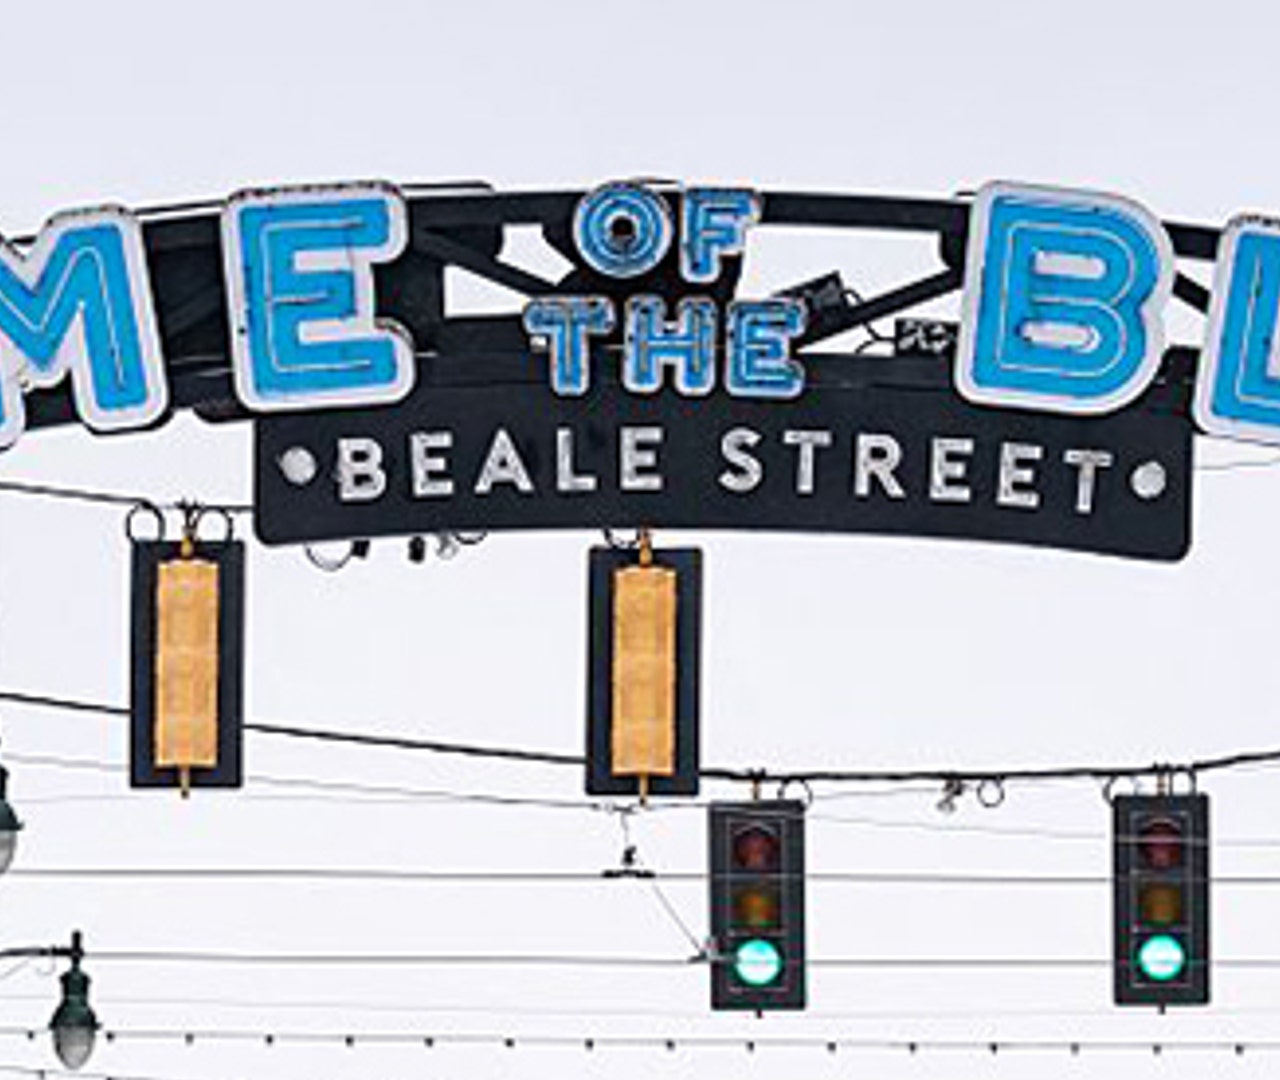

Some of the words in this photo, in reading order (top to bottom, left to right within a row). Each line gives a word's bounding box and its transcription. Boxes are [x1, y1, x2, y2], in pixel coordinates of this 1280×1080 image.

[570, 179, 763, 284] OF
[522, 293, 809, 397] THE
[337, 426, 665, 501] BEALE
[718, 427, 1114, 515] STREET
